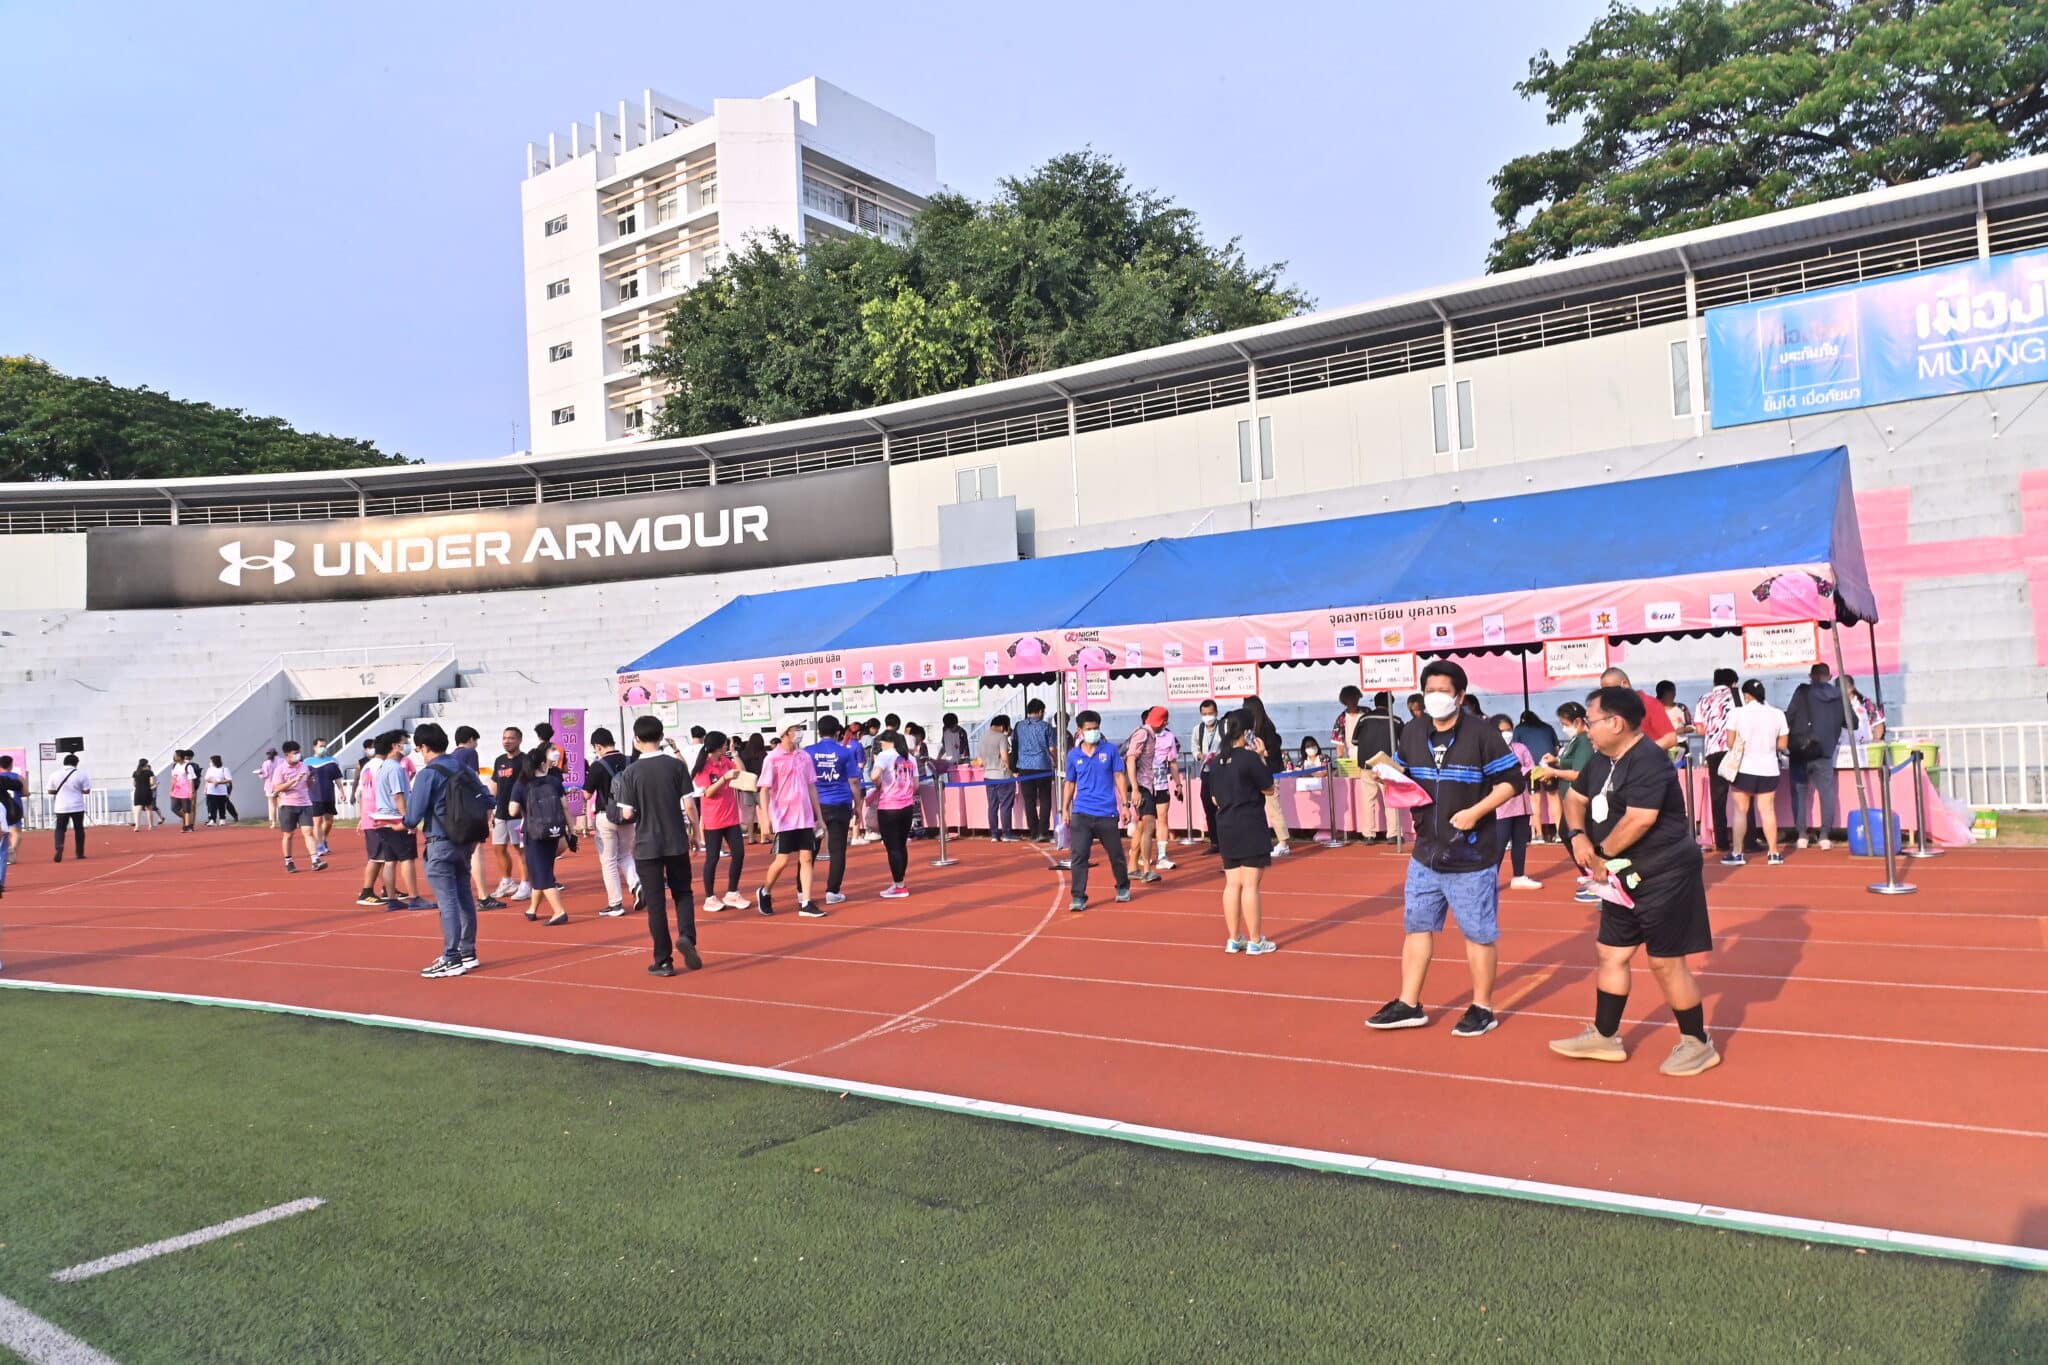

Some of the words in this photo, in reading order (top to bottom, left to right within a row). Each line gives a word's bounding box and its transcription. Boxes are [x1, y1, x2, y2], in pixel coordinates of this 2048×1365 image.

[1918, 337, 2047, 380] MUANG
[313, 531, 511, 577] UNDER
[522, 505, 769, 563] ARMOUR
[1329, 607, 1403, 627] จุดลงทะเบียน
[1408, 603, 1457, 622] บุคลากร
[360, 673, 375, 685] 12
